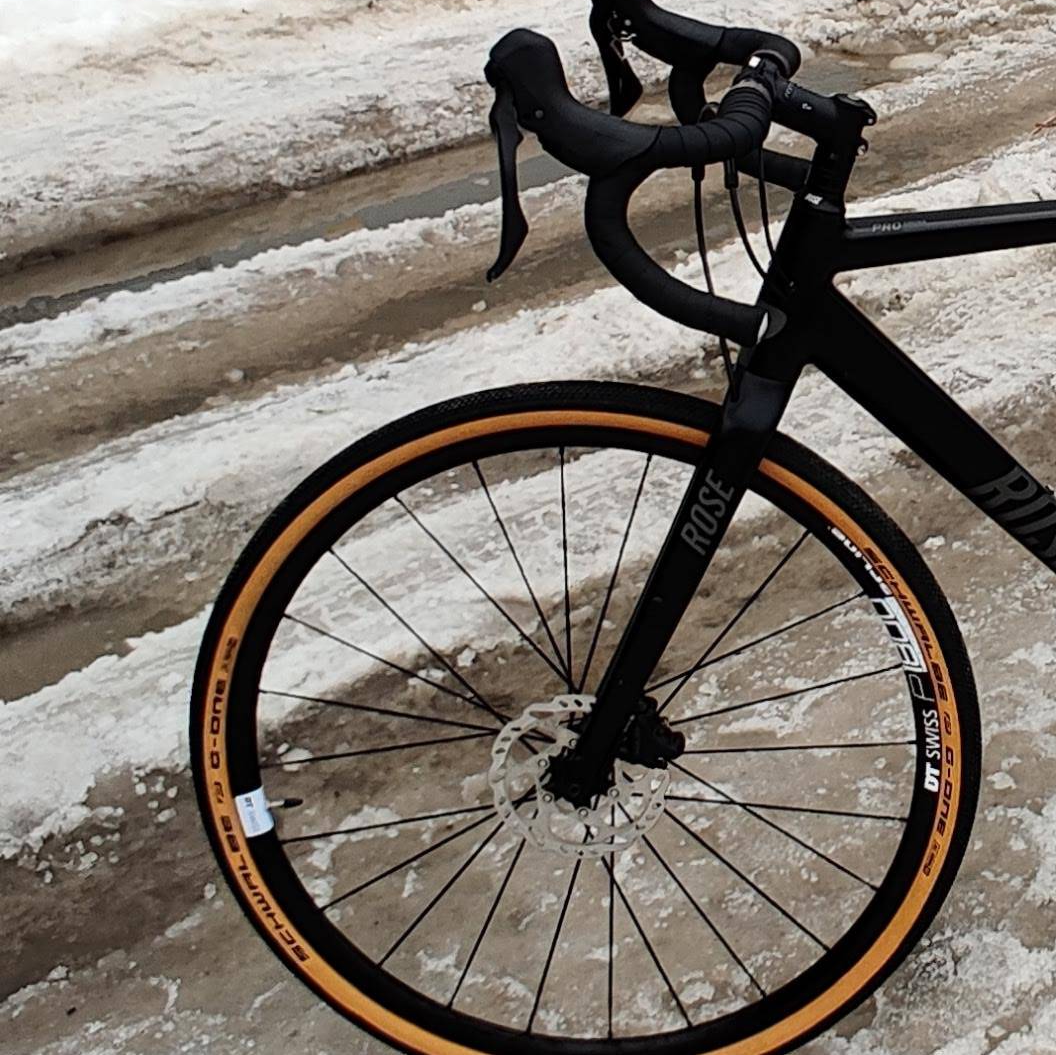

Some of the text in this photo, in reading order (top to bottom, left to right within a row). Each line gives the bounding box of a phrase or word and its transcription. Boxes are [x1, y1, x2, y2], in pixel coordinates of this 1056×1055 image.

[680, 468, 735, 556] ROSE
[863, 547, 949, 702] SCHWALBE
[923, 709, 941, 761] SWISS
[924, 761, 941, 792] DT
[220, 814, 310, 963] SCHWALBE
